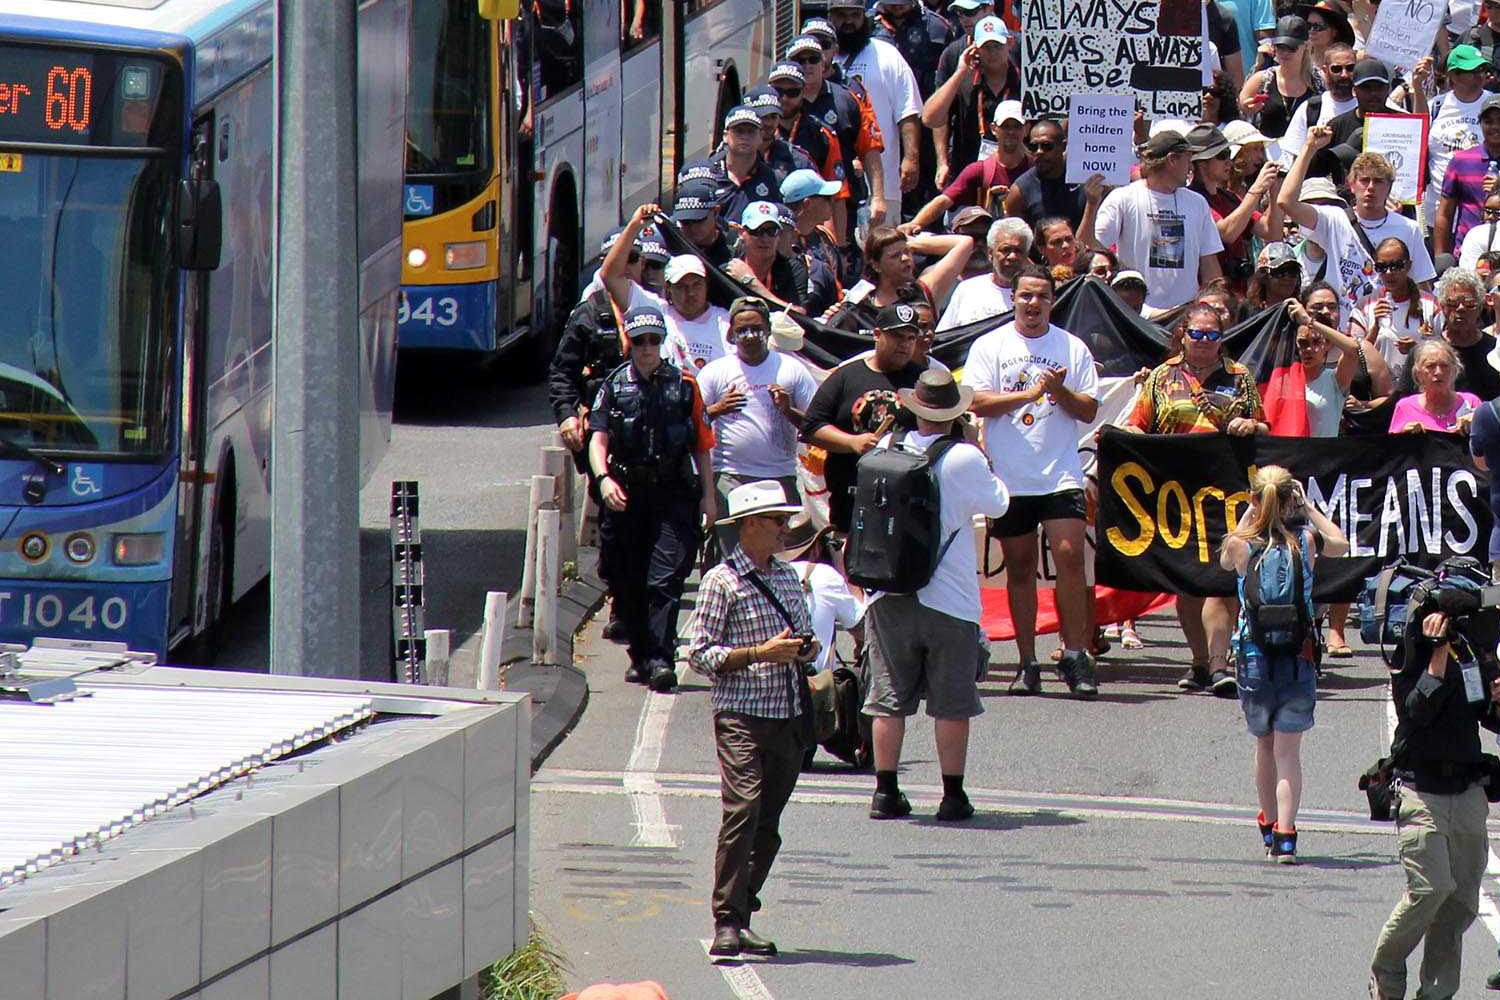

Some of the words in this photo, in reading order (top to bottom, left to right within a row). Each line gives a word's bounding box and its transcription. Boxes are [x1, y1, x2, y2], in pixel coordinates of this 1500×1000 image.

[1025, 34, 1105, 65] WAS
[1115, 36, 1202, 67] ALWAYS
[1085, 65, 1125, 88] be
[46, 65, 92, 131] 60
[1077, 106, 1106, 119] Bring
[1109, 107, 1128, 117] the
[1079, 124, 1123, 135] children
[1084, 142, 1116, 153] home
[1082, 160, 1116, 172] NOW!
[1105, 461, 1257, 563] Sorr
[1306, 467, 1478, 558] MEANS
